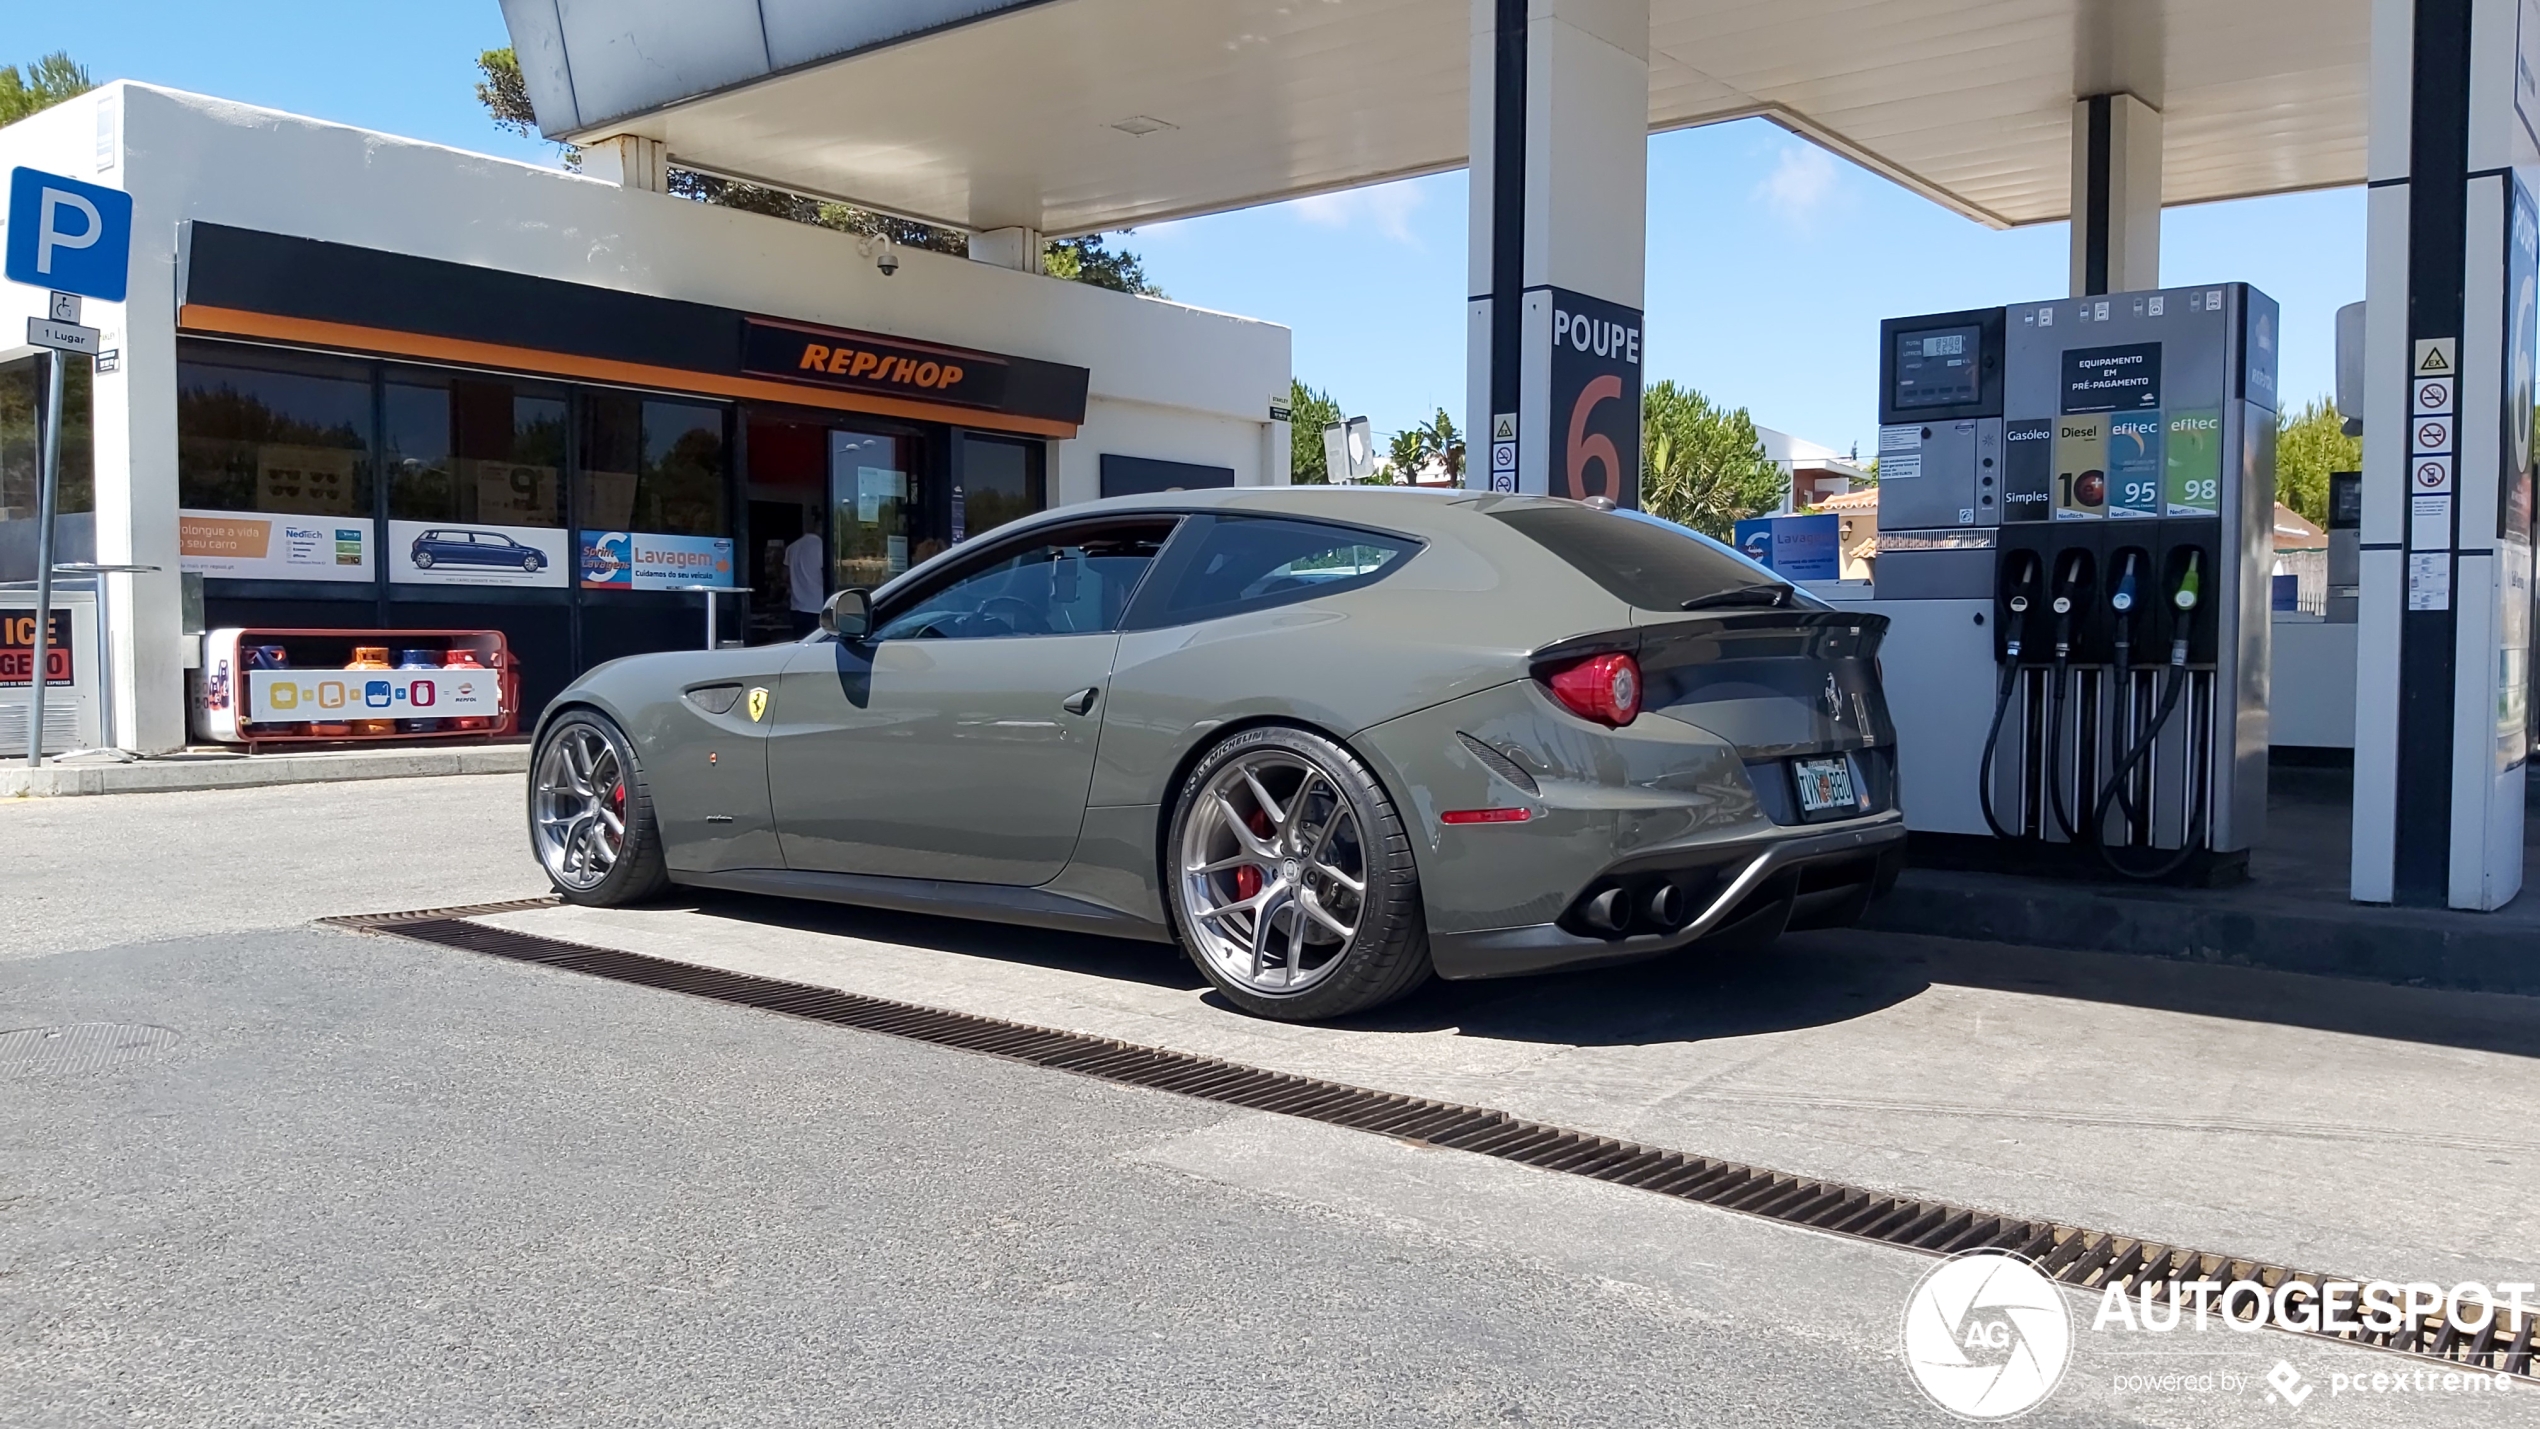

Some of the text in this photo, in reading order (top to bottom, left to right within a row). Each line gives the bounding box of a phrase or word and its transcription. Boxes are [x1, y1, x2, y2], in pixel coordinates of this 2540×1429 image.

[37, 186, 102, 274] P
[44, 328, 86, 344] 1 Lugar
[1553, 309, 1639, 364] POUPE
[799, 343, 964, 389] REPSHOP
[2078, 355, 2143, 369] EQUIPAMENTO
[2428, 359, 2441, 367] EX
[2103, 368, 2117, 377] EM
[2514, 275, 2533, 473] 6
[2072, 377, 2149, 391] PRÉ-PAGAMENTO
[2061, 425, 2097, 438] Diesel
[2112, 422, 2157, 435] efitec
[2171, 418, 2218, 431] efitec
[1567, 374, 1622, 504] 6
[2007, 428, 2050, 441] Gasóleo
[2125, 482, 2156, 503] 95
[2184, 479, 2217, 500] 98
[2005, 490, 2048, 505] Simples
[181, 526, 259, 538] olongue a vida
[187, 541, 207, 549] seu
[209, 541, 237, 550] carro
[583, 546, 615, 558] Sprint
[634, 547, 713, 569] Lavagem
[581, 560, 631, 572] Lavagens
[635, 570, 667, 578] Cuidamos
[669, 571, 676, 579] do
[5, 617, 57, 645] ICE
[0, 654, 63, 675] GEO
[1209, 731, 1263, 765] MICHELIN
